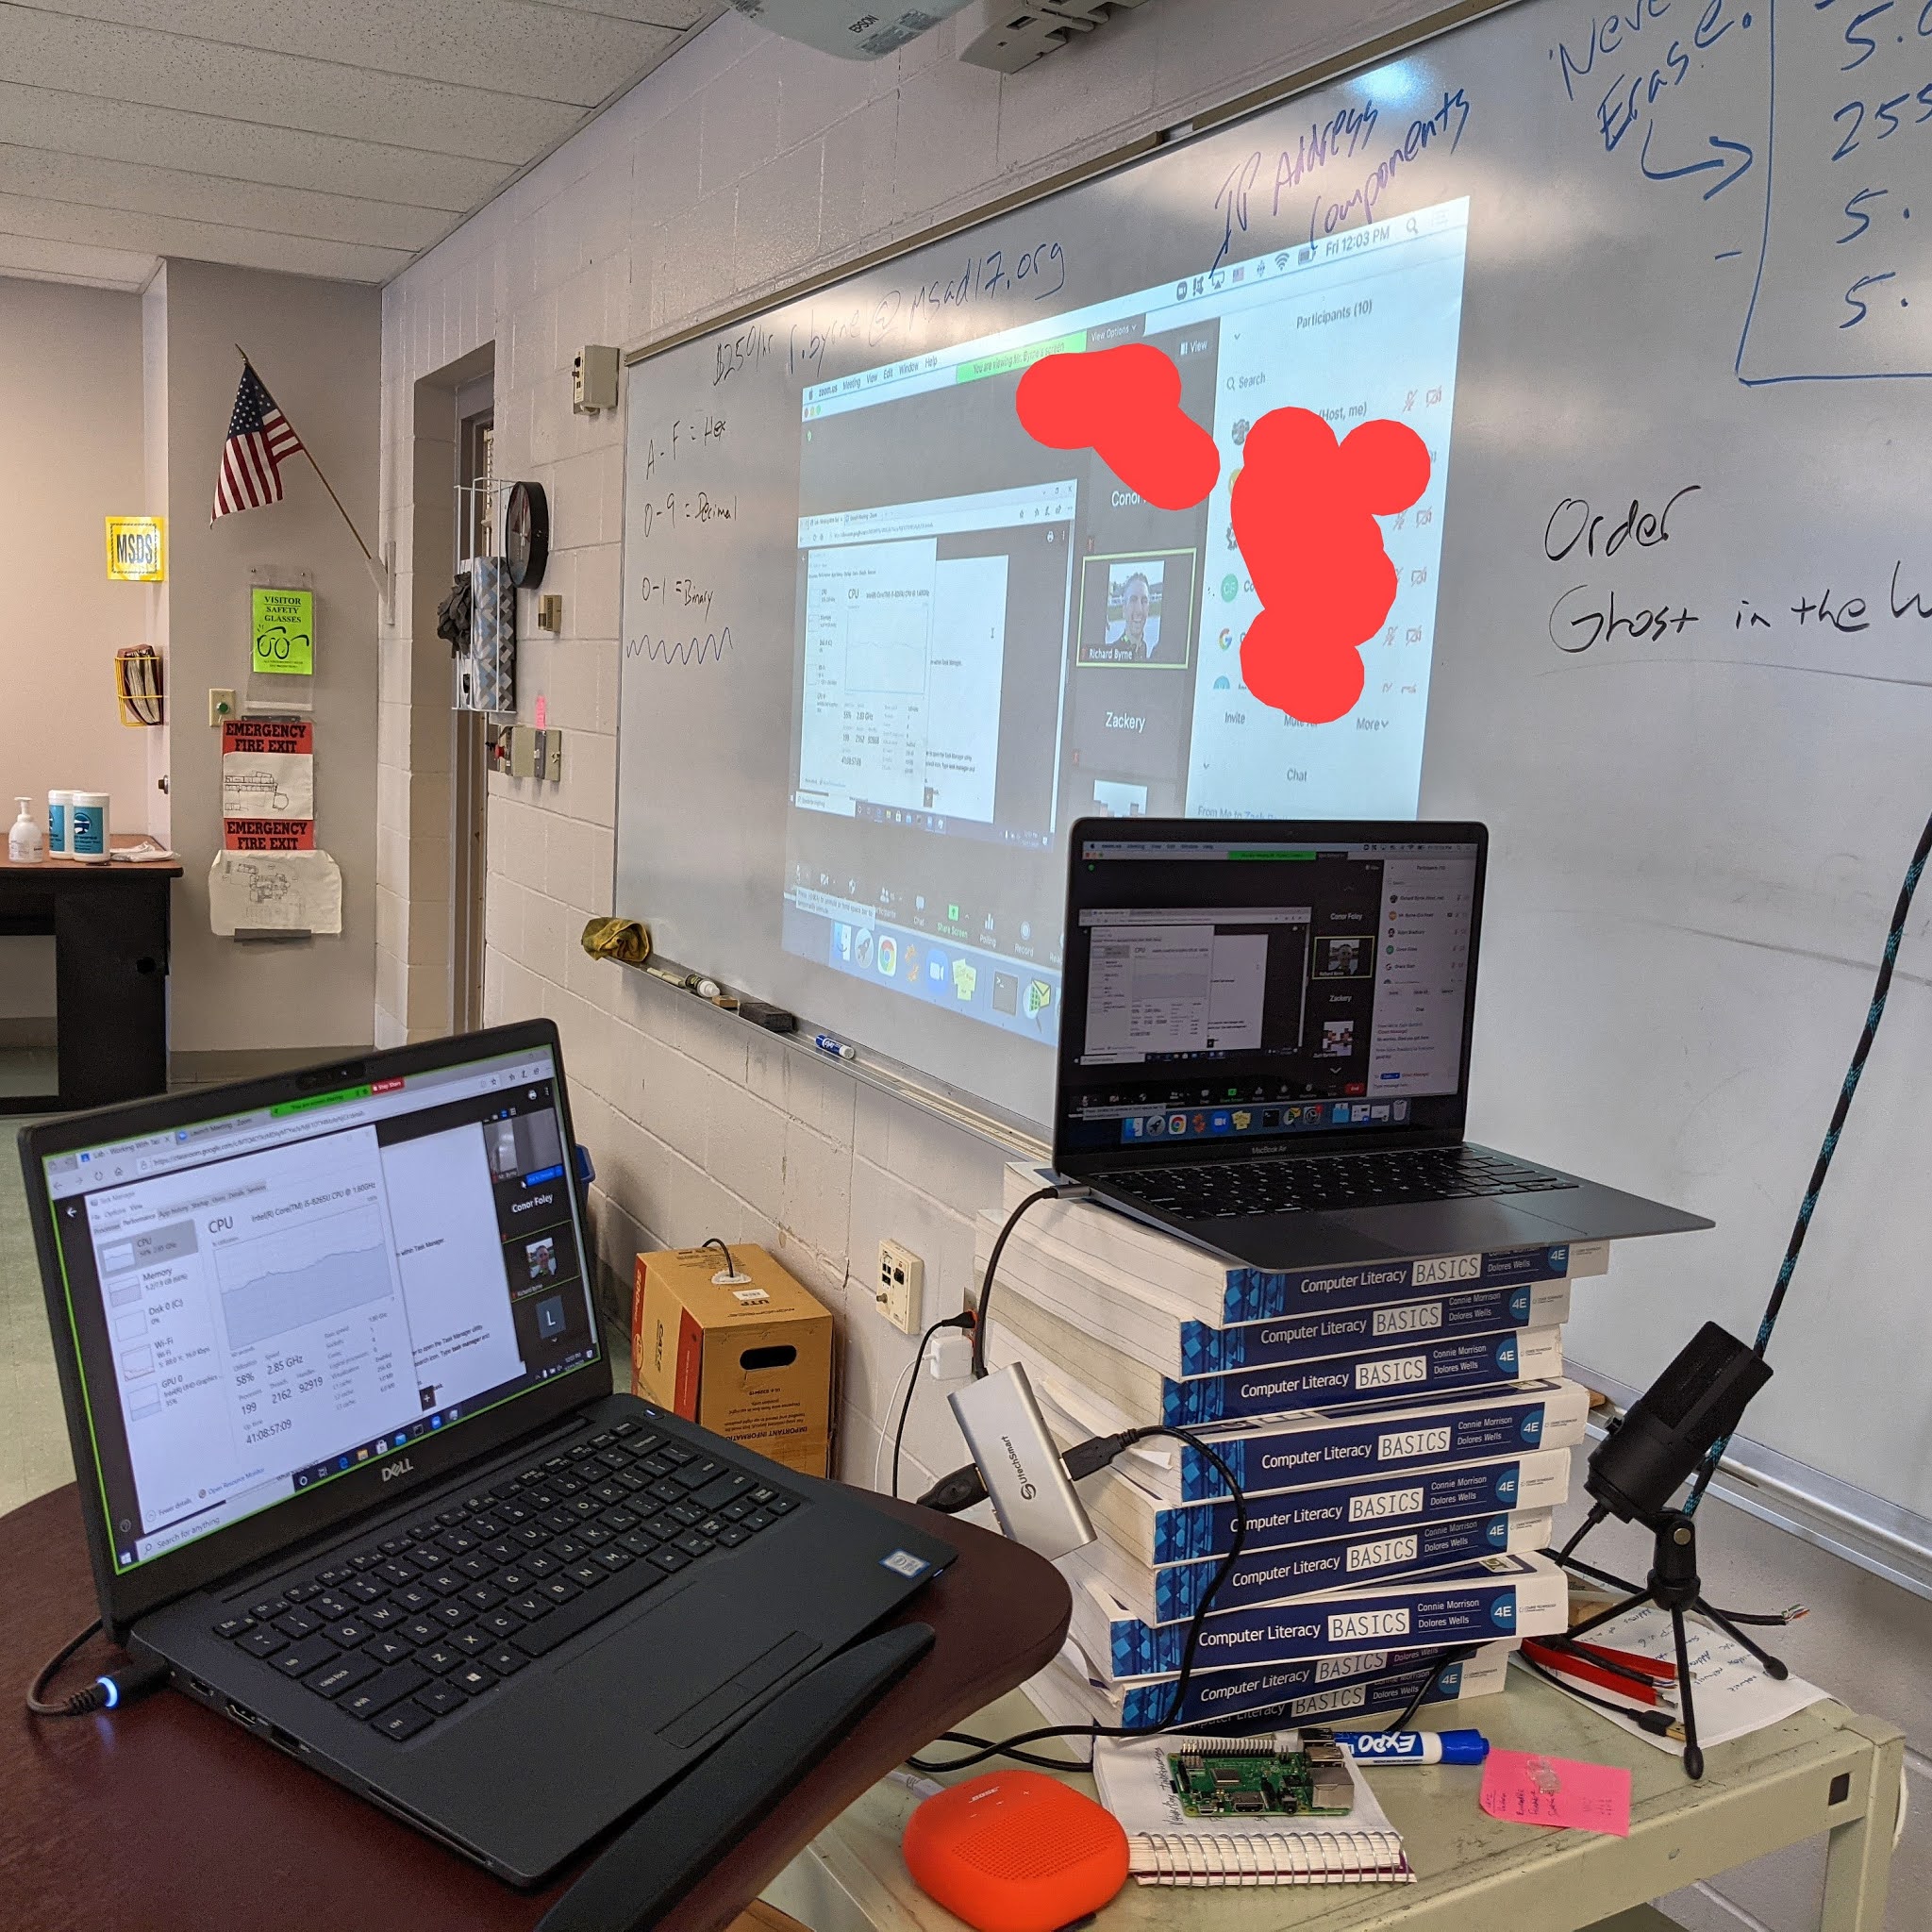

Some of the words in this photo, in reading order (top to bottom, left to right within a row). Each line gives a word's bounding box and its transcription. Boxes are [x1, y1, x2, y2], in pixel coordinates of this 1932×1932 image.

[849, 14, 879, 34] EPSON
[1274, 99, 1377, 217] Address
[1326, 235, 1339, 258] Fri
[1341, 229, 1370, 253] 12:03
[1373, 225, 1391, 246] PM
[1297, 306, 1351, 330] Participants
[1354, 298, 1373, 317] (10)
[1091, 331, 1106, 342] View
[1107, 325, 1129, 341] Options
[1190, 341, 1208, 353] View
[866, 374, 878, 384] View
[883, 369, 893, 379] Edit
[899, 362, 919, 375] Window
[924, 356, 938, 368] Help
[1239, 373, 1266, 389] Search
[1348, 402, 1367, 417] me)
[1544, 485, 1702, 562] Order
[116, 532, 154, 565] MSDS
[264, 595, 302, 606] VISITOR
[266, 606, 299, 615] SAFETY
[264, 614, 302, 625] GLASSES
[1549, 585, 1699, 654] Ghost
[1736, 600, 1772, 630] in
[1790, 589, 1871, 633] the
[1089, 648, 1112, 660] Richard
[1114, 649, 1133, 661] Byrne
[1106, 712, 1145, 733] Zackery
[1224, 712, 1245, 725] Invite
[1356, 718, 1380, 731] More
[225, 723, 307, 739] EMERGENCY
[235, 739, 265, 753] FIRE
[267, 739, 297, 753] EXIT
[1287, 769, 1307, 782] Chat
[226, 821, 308, 836] EMERGENCY
[238, 836, 267, 849] FIRE
[269, 836, 299, 849] EXIT
[1330, 912, 1347, 921] Conor
[979, 935, 996, 948] Polling
[1014, 944, 1034, 957] Record
[1252, 1146, 1275, 1155] MacBook
[252, 1210, 275, 1224] Intel(R)
[331, 1191, 345, 1201] CPU
[512, 1199, 534, 1213] Conor
[534, 1193, 554, 1208] Foley
[208, 1216, 234, 1234] CPU
[1550, 1249, 1566, 1261] 4E
[1488, 1260, 1511, 1273] Dolores
[1513, 1259, 1531, 1269] Wells
[142, 1269, 173, 1282] Memory
[1301, 1275, 1358, 1294] Computer
[1360, 1269, 1407, 1286] Literacy
[1416, 1257, 1479, 1283] BASICS
[1448, 1297, 1472, 1307] Connie
[1473, 1292, 1501, 1303] Morrison
[1511, 1298, 1527, 1309] 4E
[546, 1310, 557, 1327] L
[1449, 1310, 1473, 1322] Dolores
[1474, 1307, 1492, 1318] Wells
[1261, 1325, 1318, 1344] Computer
[1321, 1319, 1367, 1336] Literacy
[1376, 1307, 1440, 1333] BASICS
[154, 1337, 174, 1349] Wi-Fi
[1433, 1349, 1457, 1359] Connie
[1458, 1345, 1487, 1356] Morrison
[1498, 1350, 1515, 1361] 4E
[267, 1360, 285, 1375] 2.85
[286, 1355, 304, 1369] GHz
[1434, 1363, 1458, 1374] Dolores
[1460, 1361, 1478, 1371] Wells
[235, 1372, 256, 1387] 58%
[1241, 1378, 1300, 1398] Computer
[1302, 1373, 1350, 1390] Literacy
[1359, 1359, 1424, 1387] BASICS
[272, 1389, 292, 1405] 2162
[241, 1403, 258, 1416] 199
[1457, 1421, 1482, 1430] Connie
[1483, 1416, 1513, 1426] Morrison
[1523, 1422, 1540, 1433] 4E
[768, 1426, 808, 1438] IMPORTANT
[1457, 1435, 1482, 1446] Dolores
[1484, 1432, 1502, 1441] Wells
[1262, 1450, 1322, 1469] Computer
[1324, 1443, 1372, 1460] Literacy
[1382, 1430, 1448, 1457] BASICS
[1001, 1436, 1028, 1484] UtechSmart
[381, 1458, 414, 1482] DELL
[1431, 1480, 1456, 1491] Connie
[1457, 1475, 1488, 1487] Morrison
[1498, 1480, 1515, 1492] 4E
[1430, 1495, 1456, 1507] Dolores
[1457, 1491, 1476, 1502] Wells
[1230, 1512, 1291, 1533] Cmputer
[1293, 1506, 1343, 1524] Literacy
[1353, 1491, 1421, 1519] BASICS
[158, 1533, 180, 1549] Search
[192, 1517, 221, 1536] anything
[1424, 1527, 1448, 1538] Connie
[1449, 1521, 1477, 1532] Morrison
[1489, 1524, 1505, 1536] 4E
[1424, 1542, 1449, 1553] Dolores
[1450, 1537, 1469, 1548] Wells
[1232, 1564, 1291, 1588] Computer
[1292, 1557, 1341, 1575] Literacy
[1350, 1539, 1415, 1569] BASICS
[1417, 1602, 1445, 1613] Connie
[1446, 1598, 1480, 1609] Morrison
[1494, 1606, 1512, 1618] 4E
[1198, 1627, 1265, 1647] Computer
[1267, 1622, 1321, 1641] Literacy
[1332, 1612, 1407, 1639] BASICS
[1418, 1617, 1447, 1629] Dolores
[1449, 1615, 1470, 1625] Wells
[1394, 1651, 1420, 1663] Dolores
[1200, 1682, 1259, 1702] Computer
[1262, 1668, 1310, 1689] Literacy
[1320, 1652, 1385, 1680] BASICS
[1441, 1674, 1457, 1685] 4E
[1373, 1690, 1399, 1700] Dolores
[1400, 1685, 1419, 1695] Wells
[1296, 1687, 1362, 1715] BASICS
[1357, 1731, 1417, 1755] EXPO
